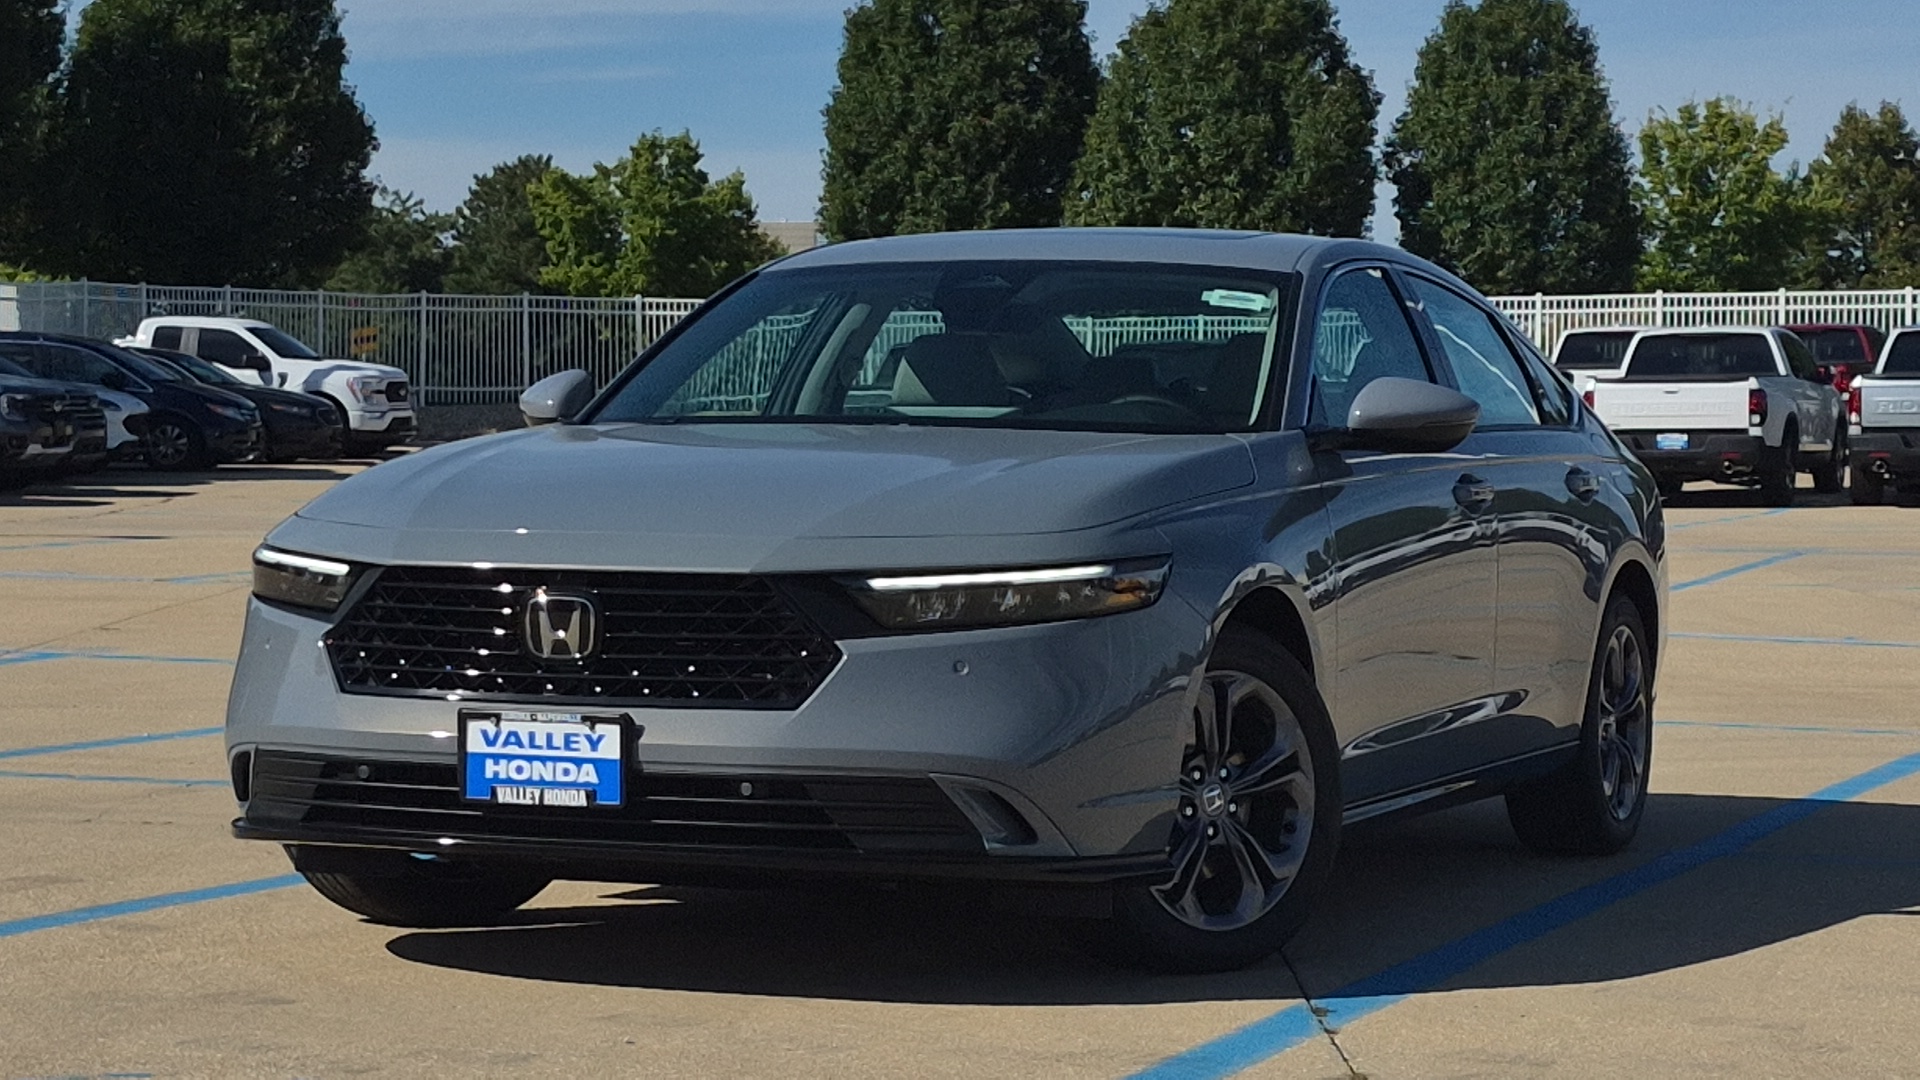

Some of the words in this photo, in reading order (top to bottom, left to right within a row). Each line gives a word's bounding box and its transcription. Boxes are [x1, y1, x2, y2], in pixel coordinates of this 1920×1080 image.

[480, 728, 606, 752] VALLEY
[485, 758, 599, 784] HONDA
[496, 786, 540, 805] VALLEY
[543, 788, 588, 807] HONDA
